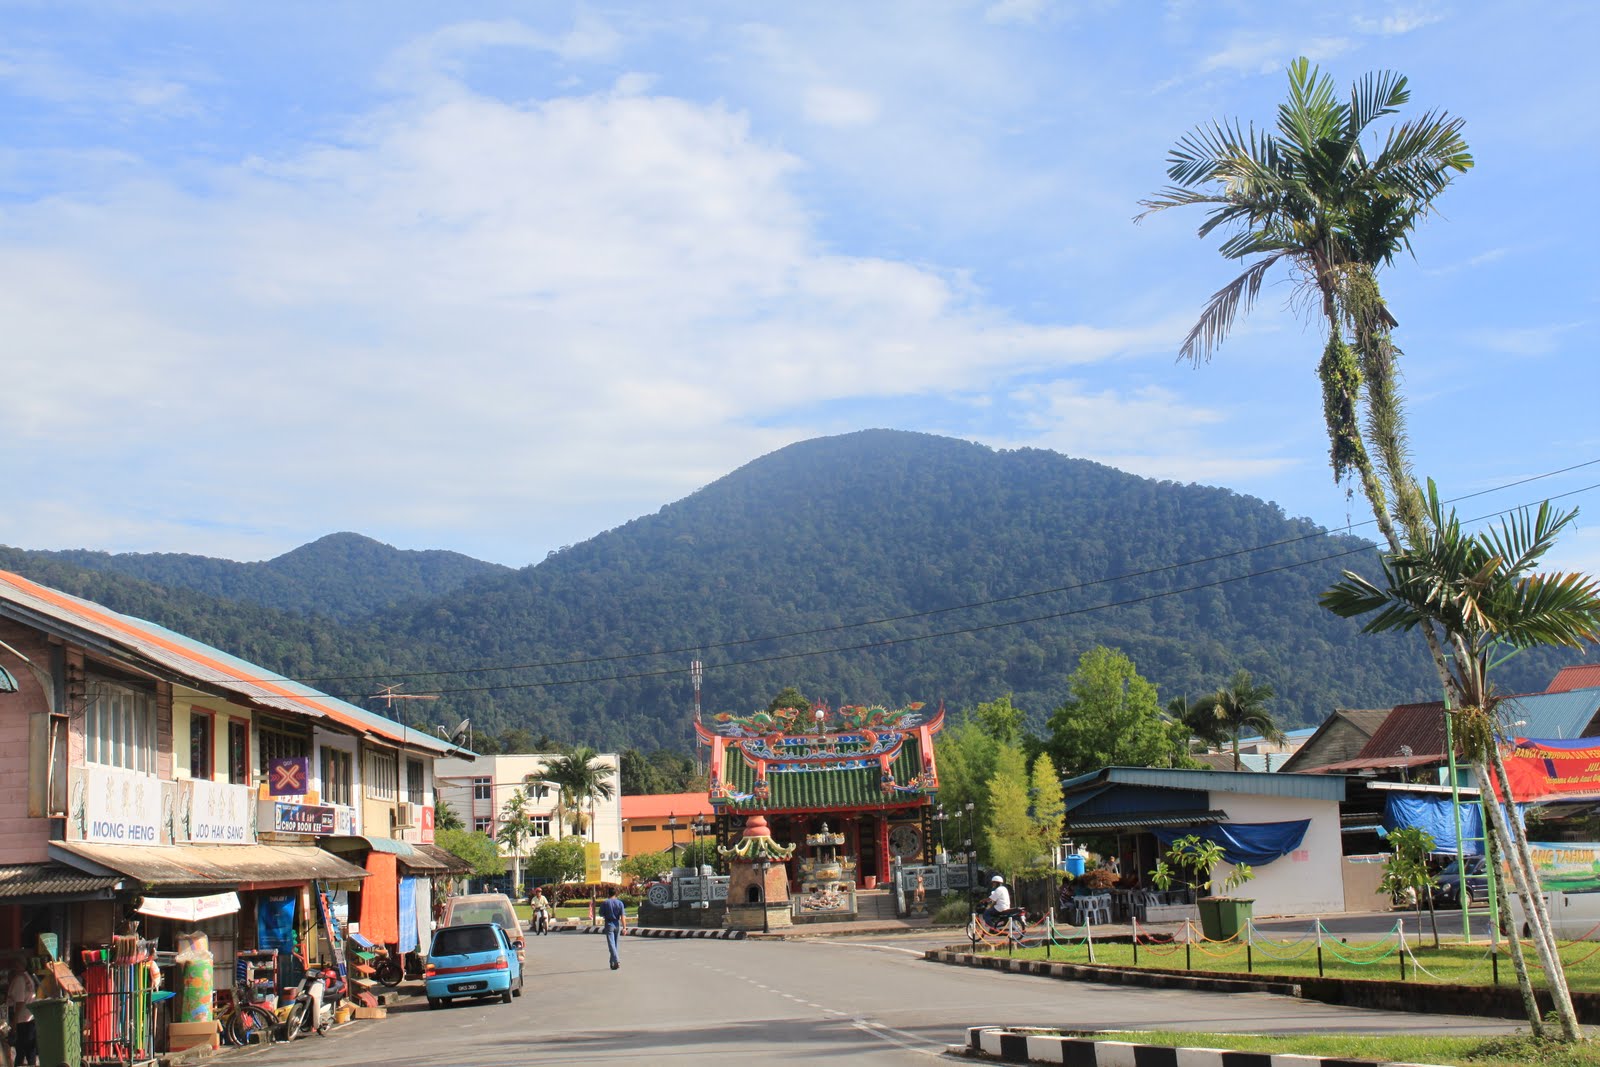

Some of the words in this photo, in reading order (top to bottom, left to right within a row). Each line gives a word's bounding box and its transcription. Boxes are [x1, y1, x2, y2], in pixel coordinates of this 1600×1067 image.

[93, 821, 124, 838] MONG
[128, 825, 154, 840] HENG
[196, 823, 209, 838] JOO
[211, 825, 224, 839] HAK
[227, 826, 243, 840] SANG
[282, 821, 296, 831] CHOP
[297, 822, 312, 832] BOON
[313, 822, 322, 832] KEE
[1556, 849, 1594, 863] TAHUN
